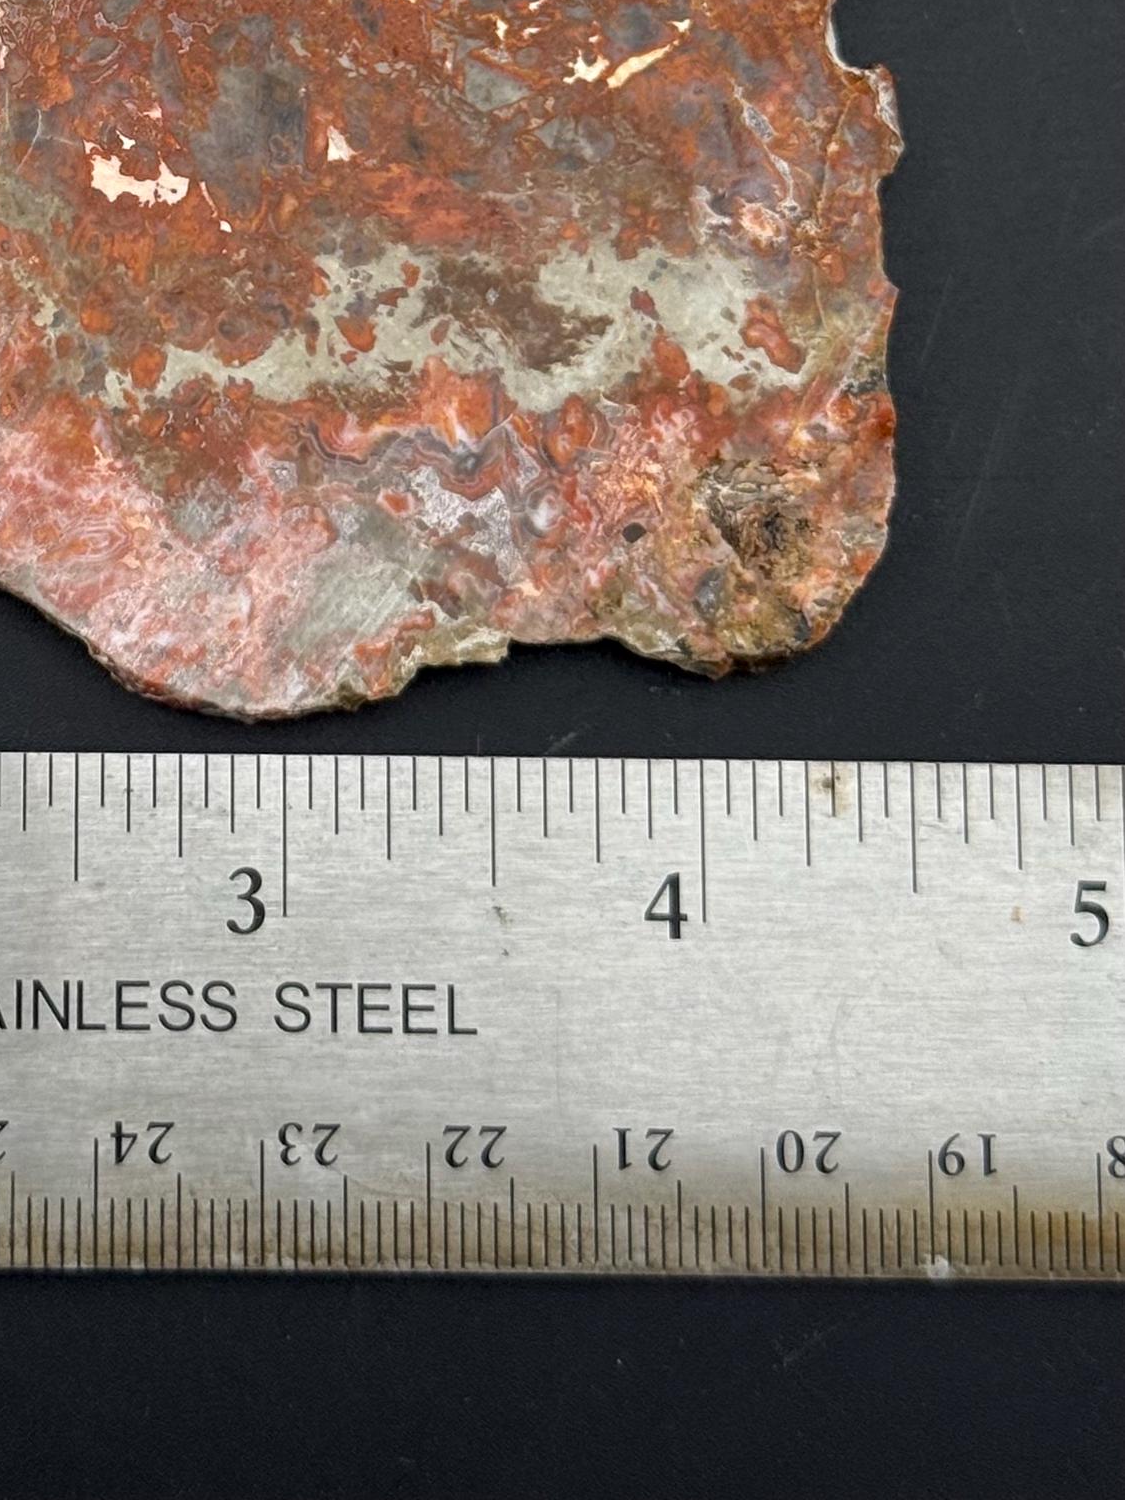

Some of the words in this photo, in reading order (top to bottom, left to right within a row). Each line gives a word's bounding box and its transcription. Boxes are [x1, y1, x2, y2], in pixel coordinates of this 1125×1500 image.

[225, 866, 267, 935] 3
[643, 871, 688, 941] 4
[1069, 878, 1111, 948] 5
[272, 981, 478, 1037] STEEL
[110, 1120, 176, 1166] 24
[278, 1121, 341, 1167] 23
[442, 1124, 508, 1170] 22
[613, 1126, 676, 1173] 21
[775, 1129, 843, 1174] 20
[936, 1132, 998, 1177] 19
